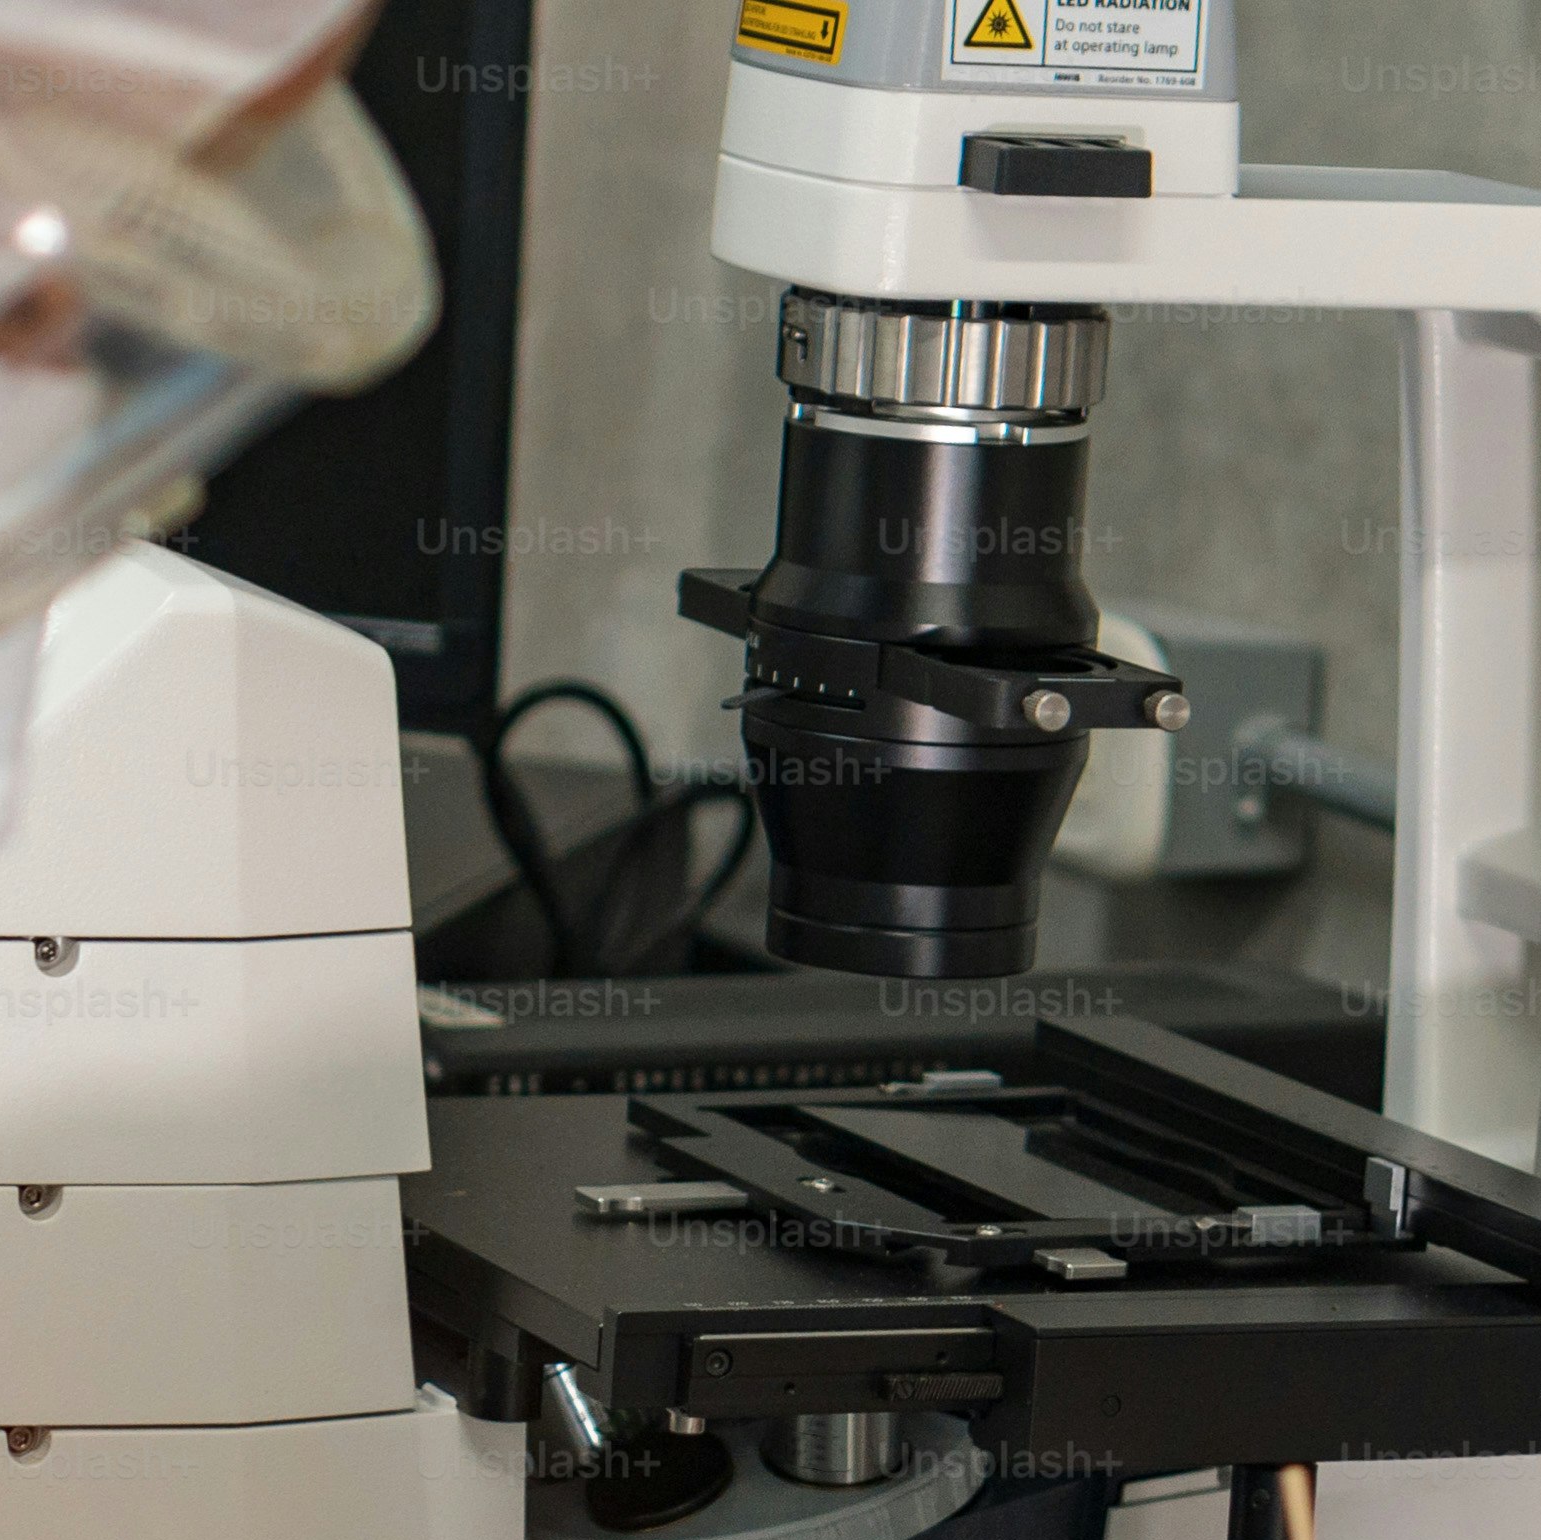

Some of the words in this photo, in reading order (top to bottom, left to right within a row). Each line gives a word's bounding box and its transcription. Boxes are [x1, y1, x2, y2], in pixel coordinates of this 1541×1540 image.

[1055, 18, 1074, 32] Do
[1079, 20, 1102, 33] not
[1107, 22, 1140, 34] stare
[1054, 39, 1068, 51] at
[1072, 39, 1139, 57] operating
[1144, 41, 1178, 57] lamp
